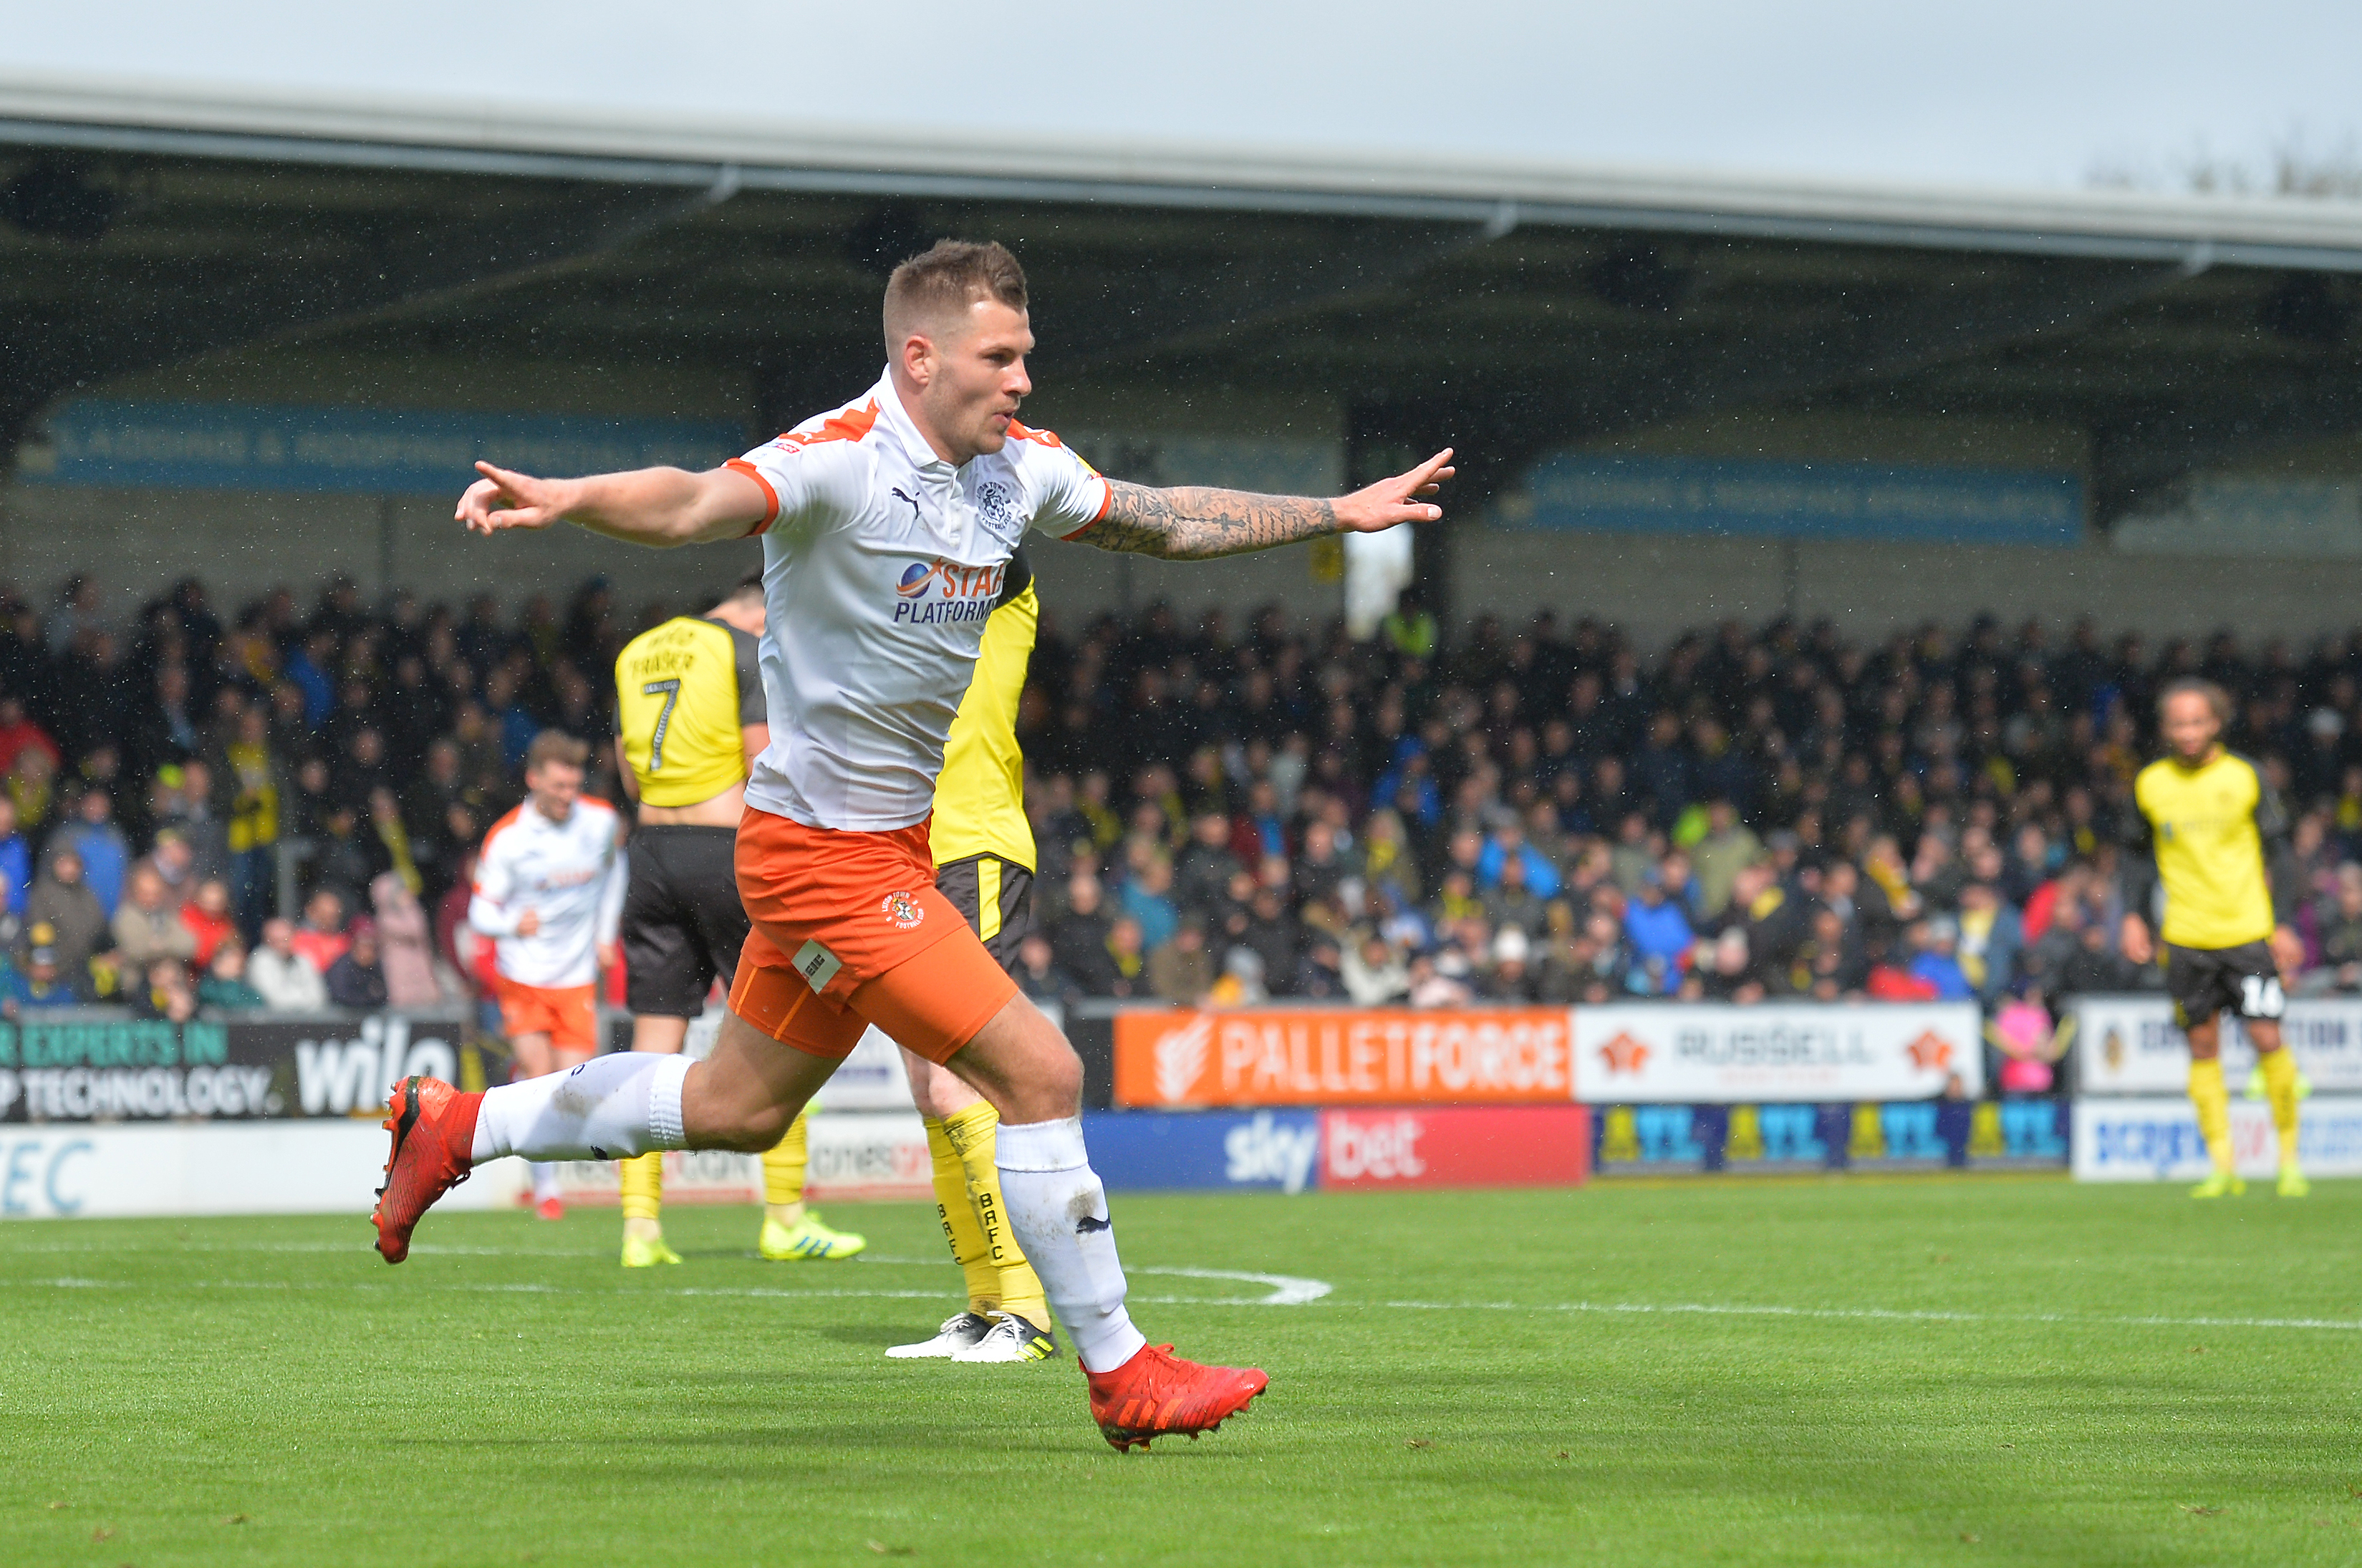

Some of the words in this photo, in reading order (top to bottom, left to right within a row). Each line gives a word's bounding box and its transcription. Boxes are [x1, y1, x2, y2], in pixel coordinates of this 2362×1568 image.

[643, 678, 681, 772] 7
[22, 1023, 179, 1067] EXPERTS
[184, 1024, 228, 1066] IN
[296, 1016, 457, 1114] wilo
[1221, 1021, 1566, 1091] PALLETFORCE
[1225, 1112, 1319, 1195] sky
[1328, 1115, 1425, 1179] bet
